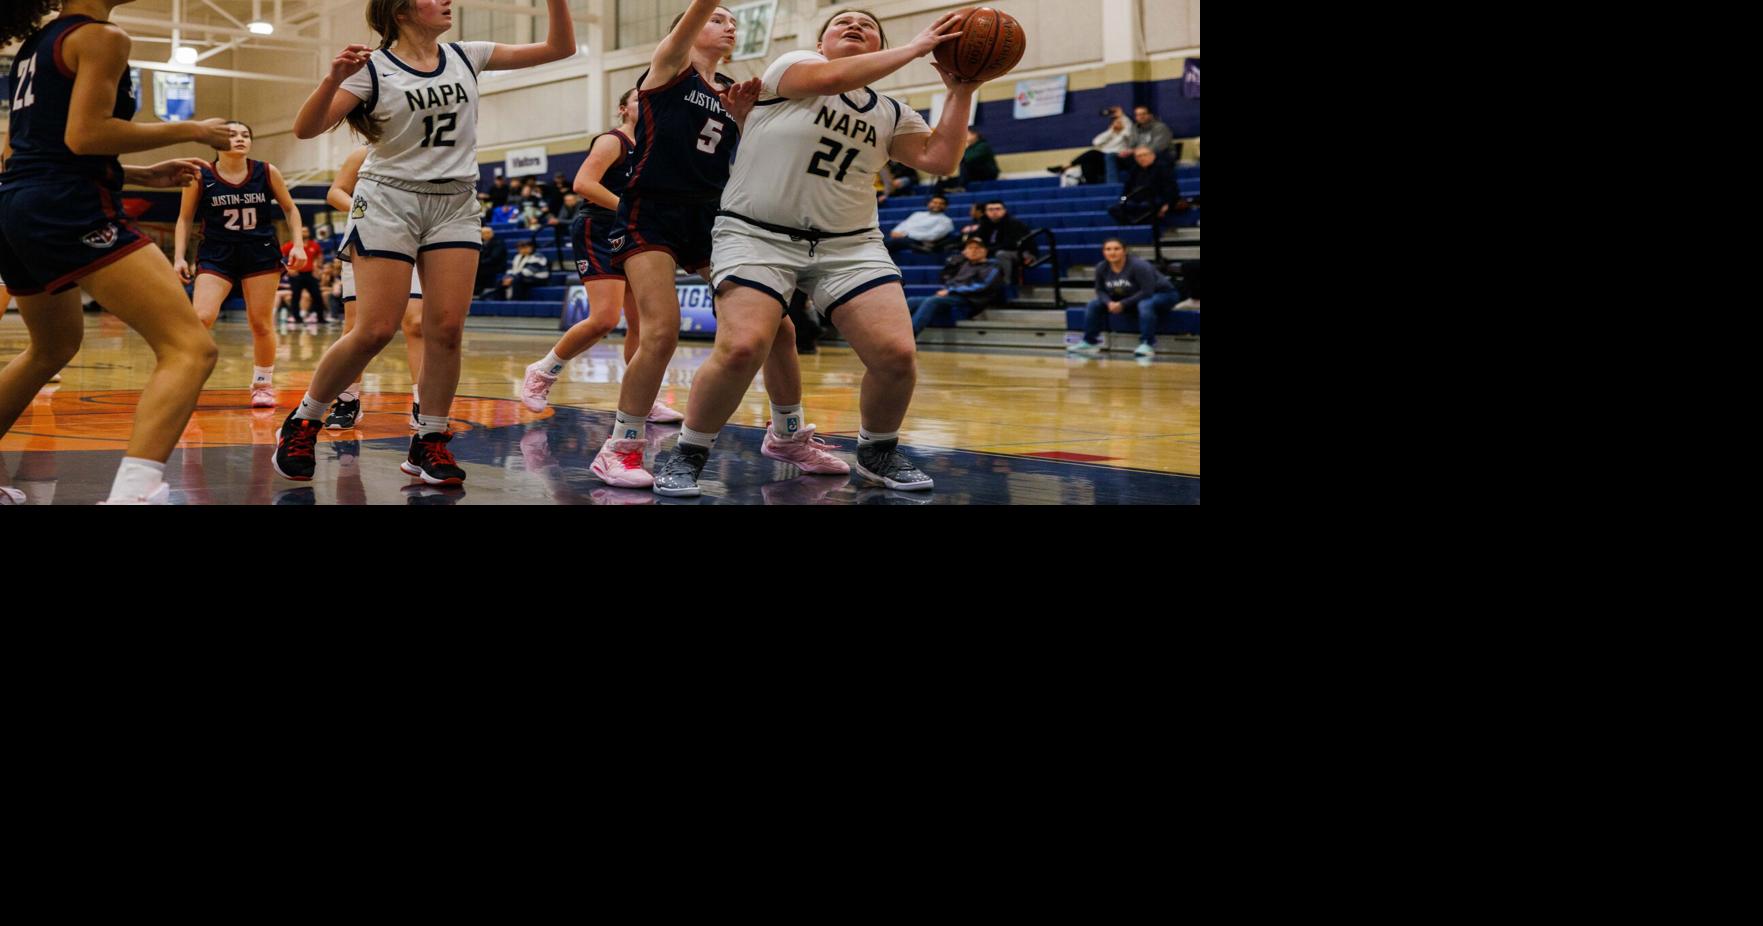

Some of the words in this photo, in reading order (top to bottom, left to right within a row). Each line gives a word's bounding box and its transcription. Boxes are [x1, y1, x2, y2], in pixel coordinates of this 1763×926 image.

[12, 52, 37, 111] 21
[404, 82, 469, 112] NAPA
[420, 112, 457, 148] 12
[696, 117, 725, 154] 5
[813, 105, 877, 148] NAPA
[806, 136, 860, 182] 21
[210, 192, 266, 207] JUSTIN-SIENA
[223, 207, 257, 231] 20
[677, 287, 713, 309] IGH
